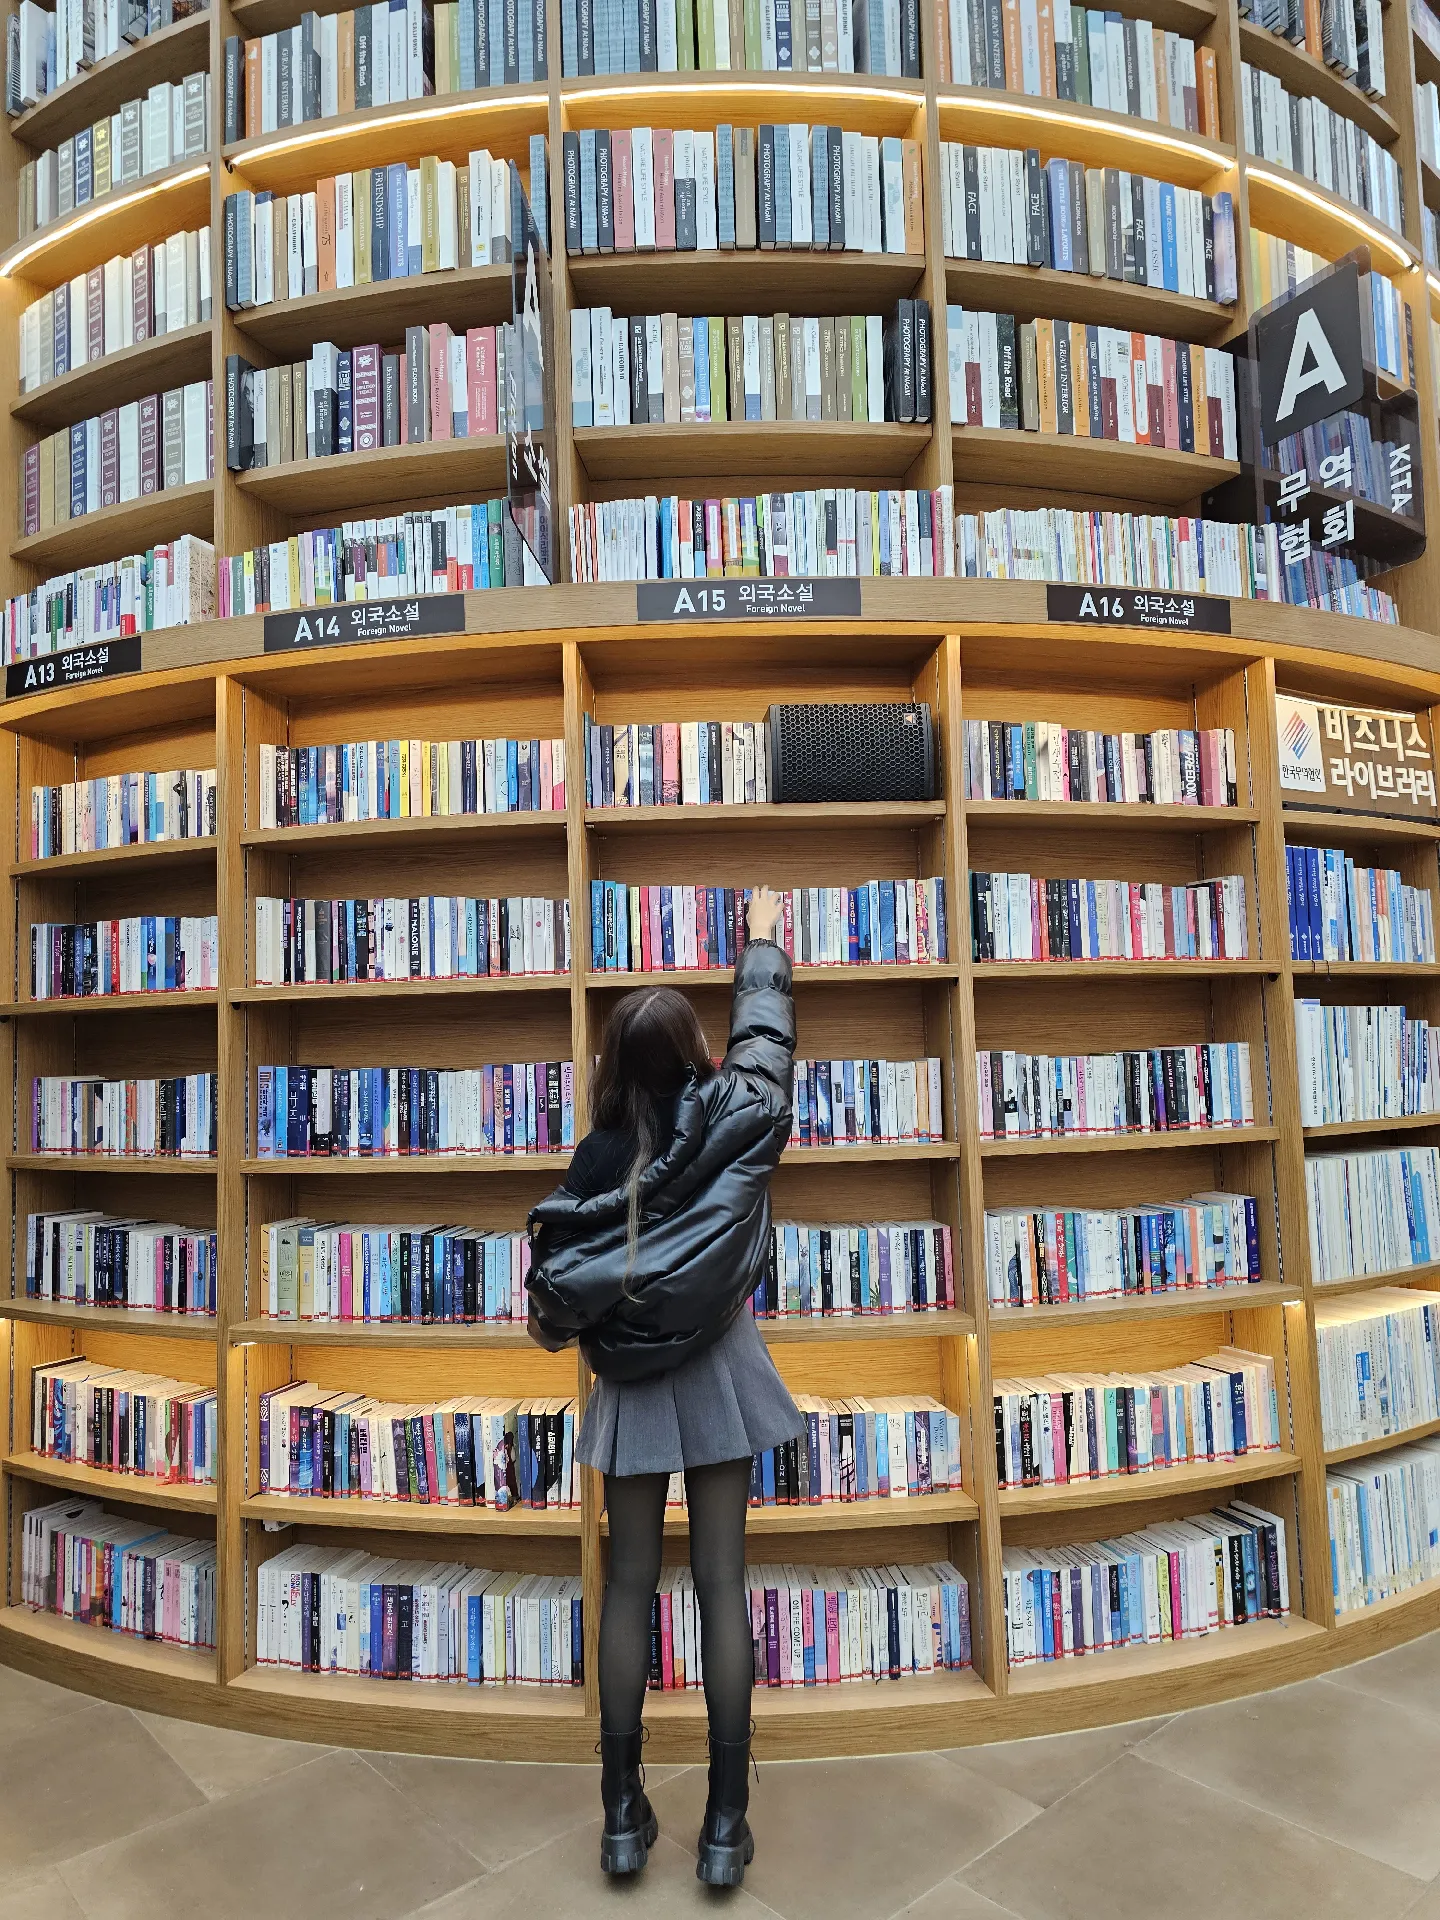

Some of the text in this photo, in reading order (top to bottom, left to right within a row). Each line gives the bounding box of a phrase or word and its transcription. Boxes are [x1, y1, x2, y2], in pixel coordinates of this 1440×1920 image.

[992, 39, 1001, 79] INTERIOR
[568, 151, 576, 198] PHOTOGRAPY
[599, 148, 608, 196] PHOTOGRAPY
[763, 143, 771, 192] PHOTOGRAPY
[832, 145, 841, 194] PHOTOGRAPY
[374, 171, 384, 229] FRIENDSHIP
[967, 191, 977, 215] FACE
[1030, 193, 1040, 216] FACE
[1061, 228, 1069, 260] LAYOUTS
[1135, 218, 1144, 241] FACE
[1166, 217, 1174, 243] DESIGN
[1151, 233, 1159, 276] CLASSIC
[1205, 238, 1213, 260] FACE
[1003, 345, 1013, 398] Off the Road
[1275, 307, 1348, 423] A
[699, 370, 707, 404] INTERIOR
[1061, 374, 1069, 414] INTERIOR
[1389, 443, 1413, 514] KITA
[672, 587, 726, 614] A15
[738, 583, 814, 603] 외국소설
[1078, 592, 1125, 618] A16
[1133, 594, 1196, 617] 외국소설
[350, 601, 420, 626] 외국소설
[746, 603, 806, 614] Foreign Novel
[1140, 613, 1190, 627] Foreign Novel
[293, 615, 340, 643] A14
[357, 622, 412, 638] Foreign Novel
[61, 646, 110, 671] 외국소설
[65, 665, 104, 681] Foreign Novel
[24, 662, 55, 689] A13
[1323, 708, 1431, 762] 비즈니스
[1183, 751, 1197, 799] FREEDOM
[1329, 757, 1438, 807] 라이브러리
[411, 919, 419, 956] MALORIE
